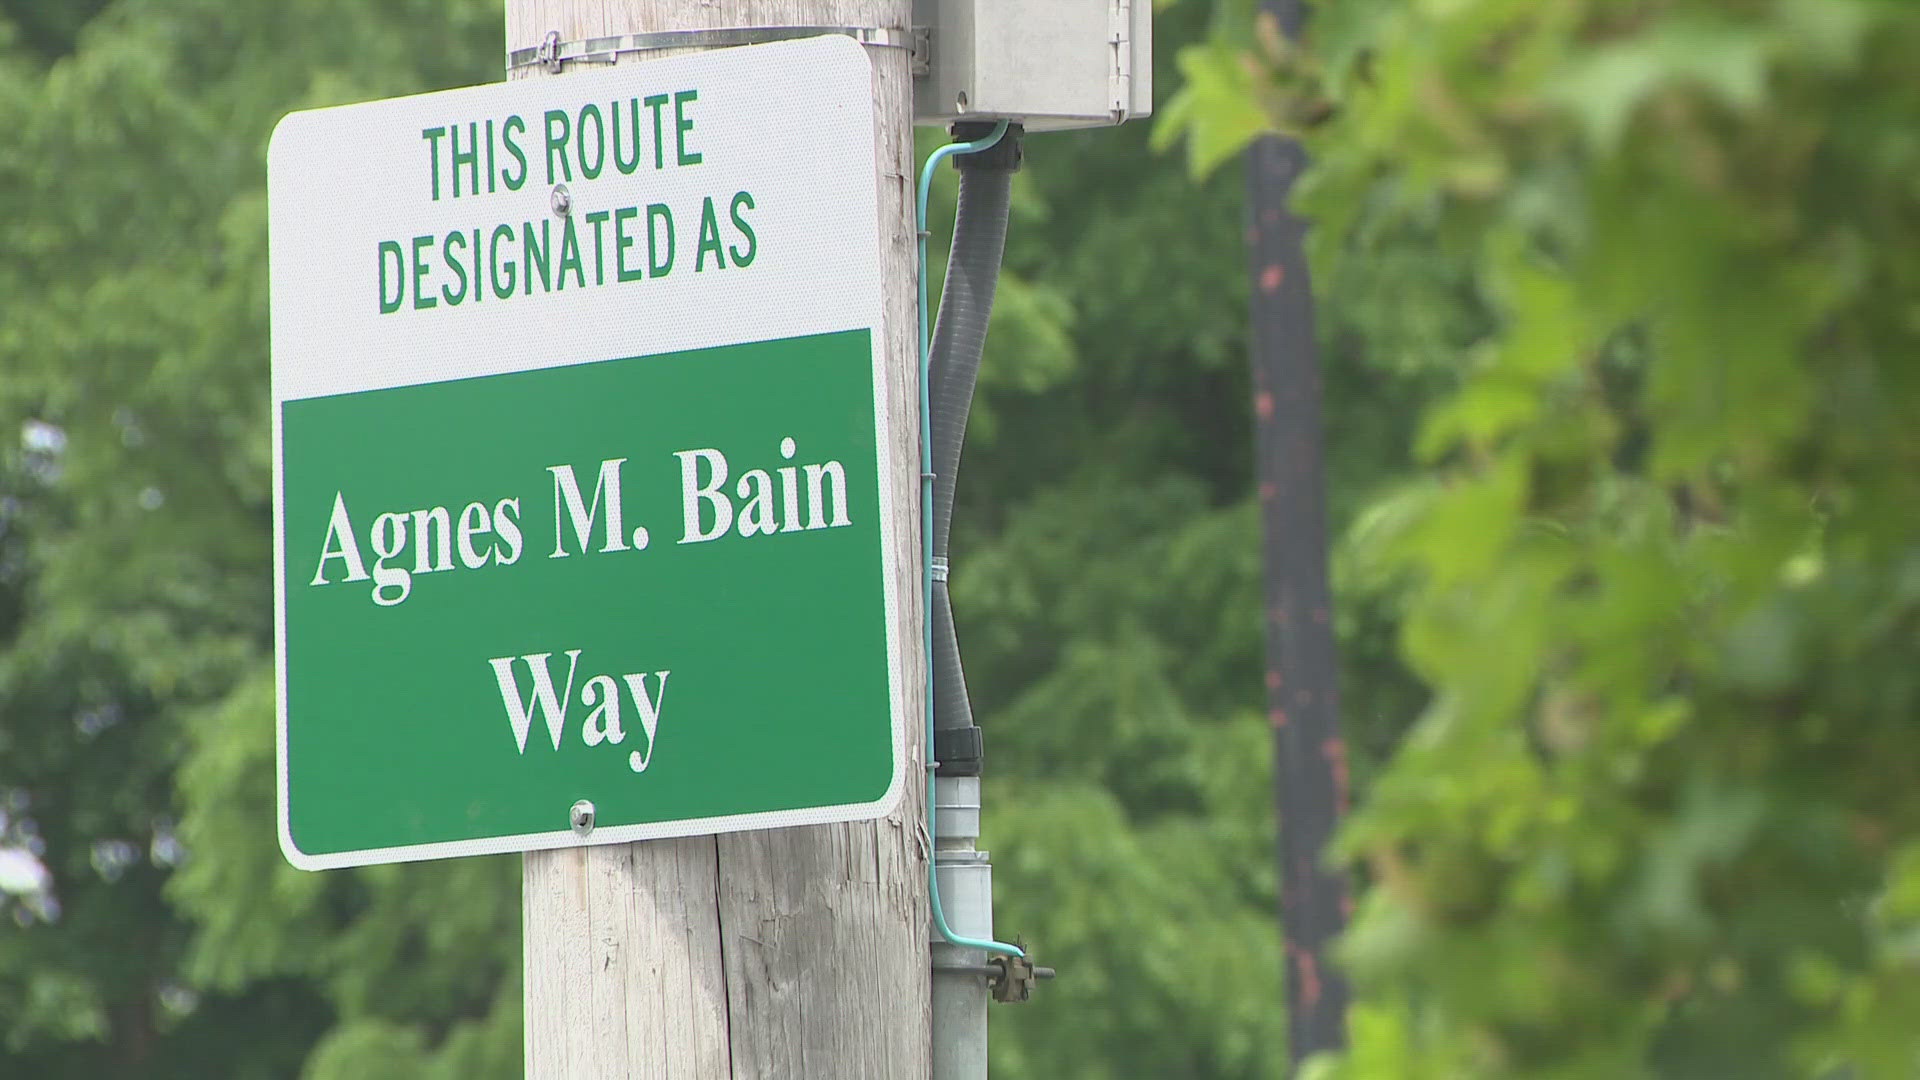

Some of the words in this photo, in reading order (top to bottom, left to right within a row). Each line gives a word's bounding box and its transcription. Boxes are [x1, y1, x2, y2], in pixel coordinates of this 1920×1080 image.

[422, 115, 528, 201] THIS
[544, 89, 703, 185] ROUTE
[378, 203, 676, 315] DESIGNATED
[695, 191, 757, 273] AS
[309, 490, 523, 607] Agnes
[545, 457, 649, 559] M.
[672, 436, 853, 545] Bain
[488, 649, 671, 774] Way
